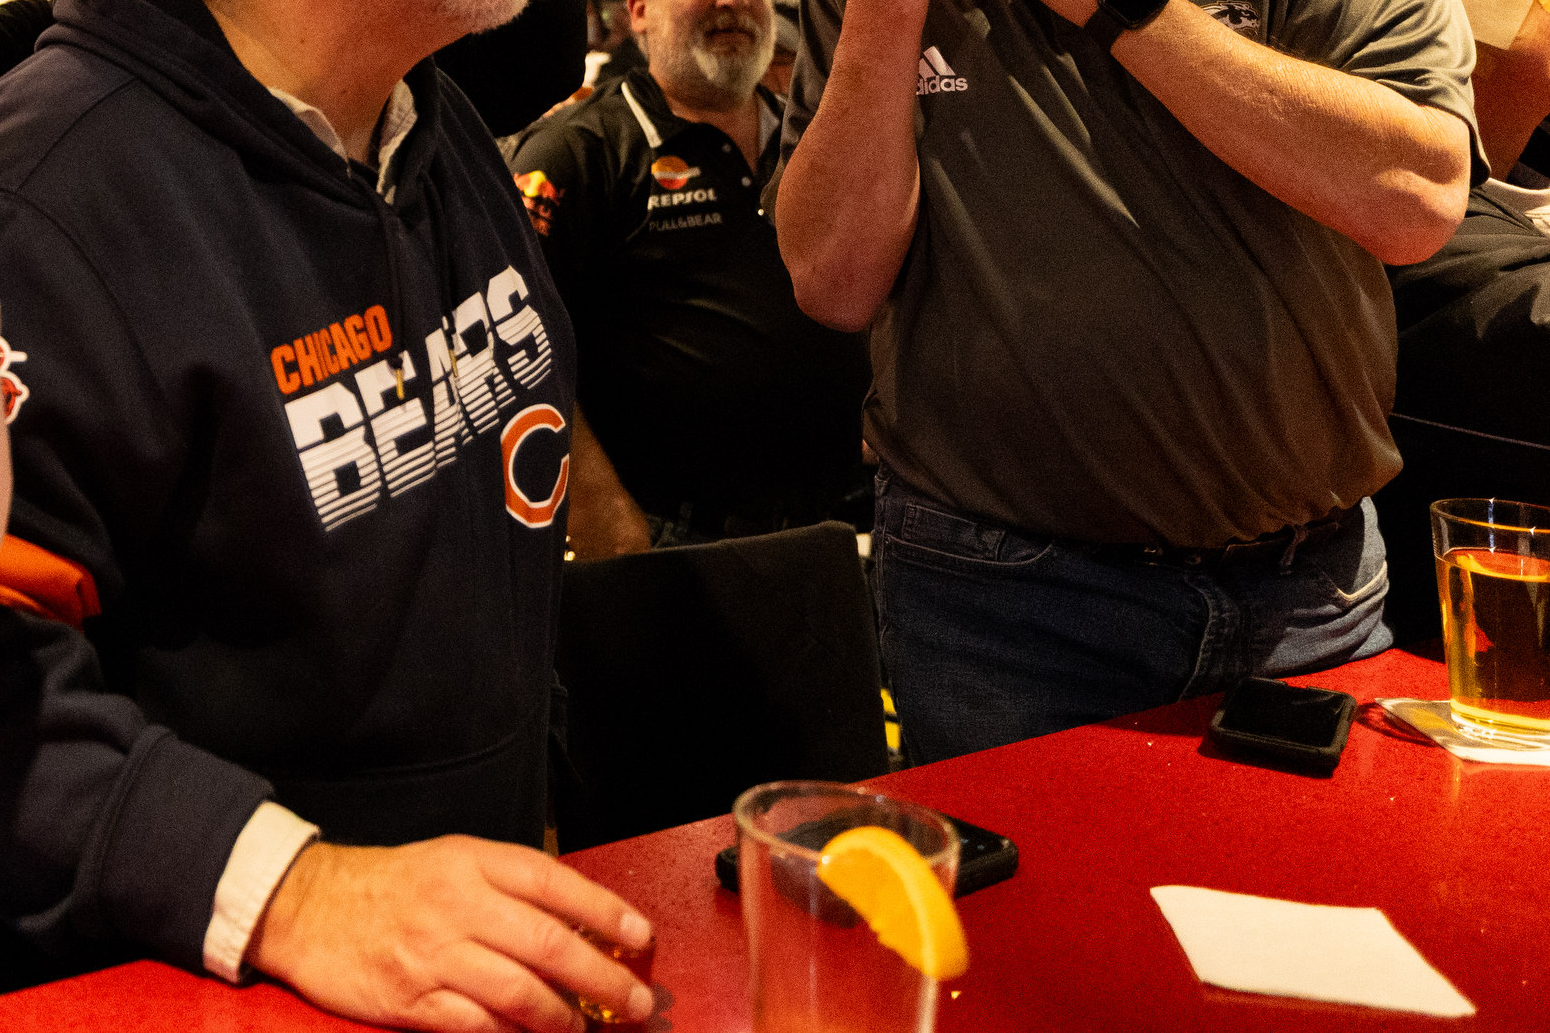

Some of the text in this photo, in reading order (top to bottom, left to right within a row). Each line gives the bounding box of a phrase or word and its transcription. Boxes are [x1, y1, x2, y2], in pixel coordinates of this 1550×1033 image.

[915, 75, 969, 96] didas
[647, 187, 718, 211] REPSOL
[270, 304, 393, 395] CHICAGO
[284, 265, 553, 533] BEARS
